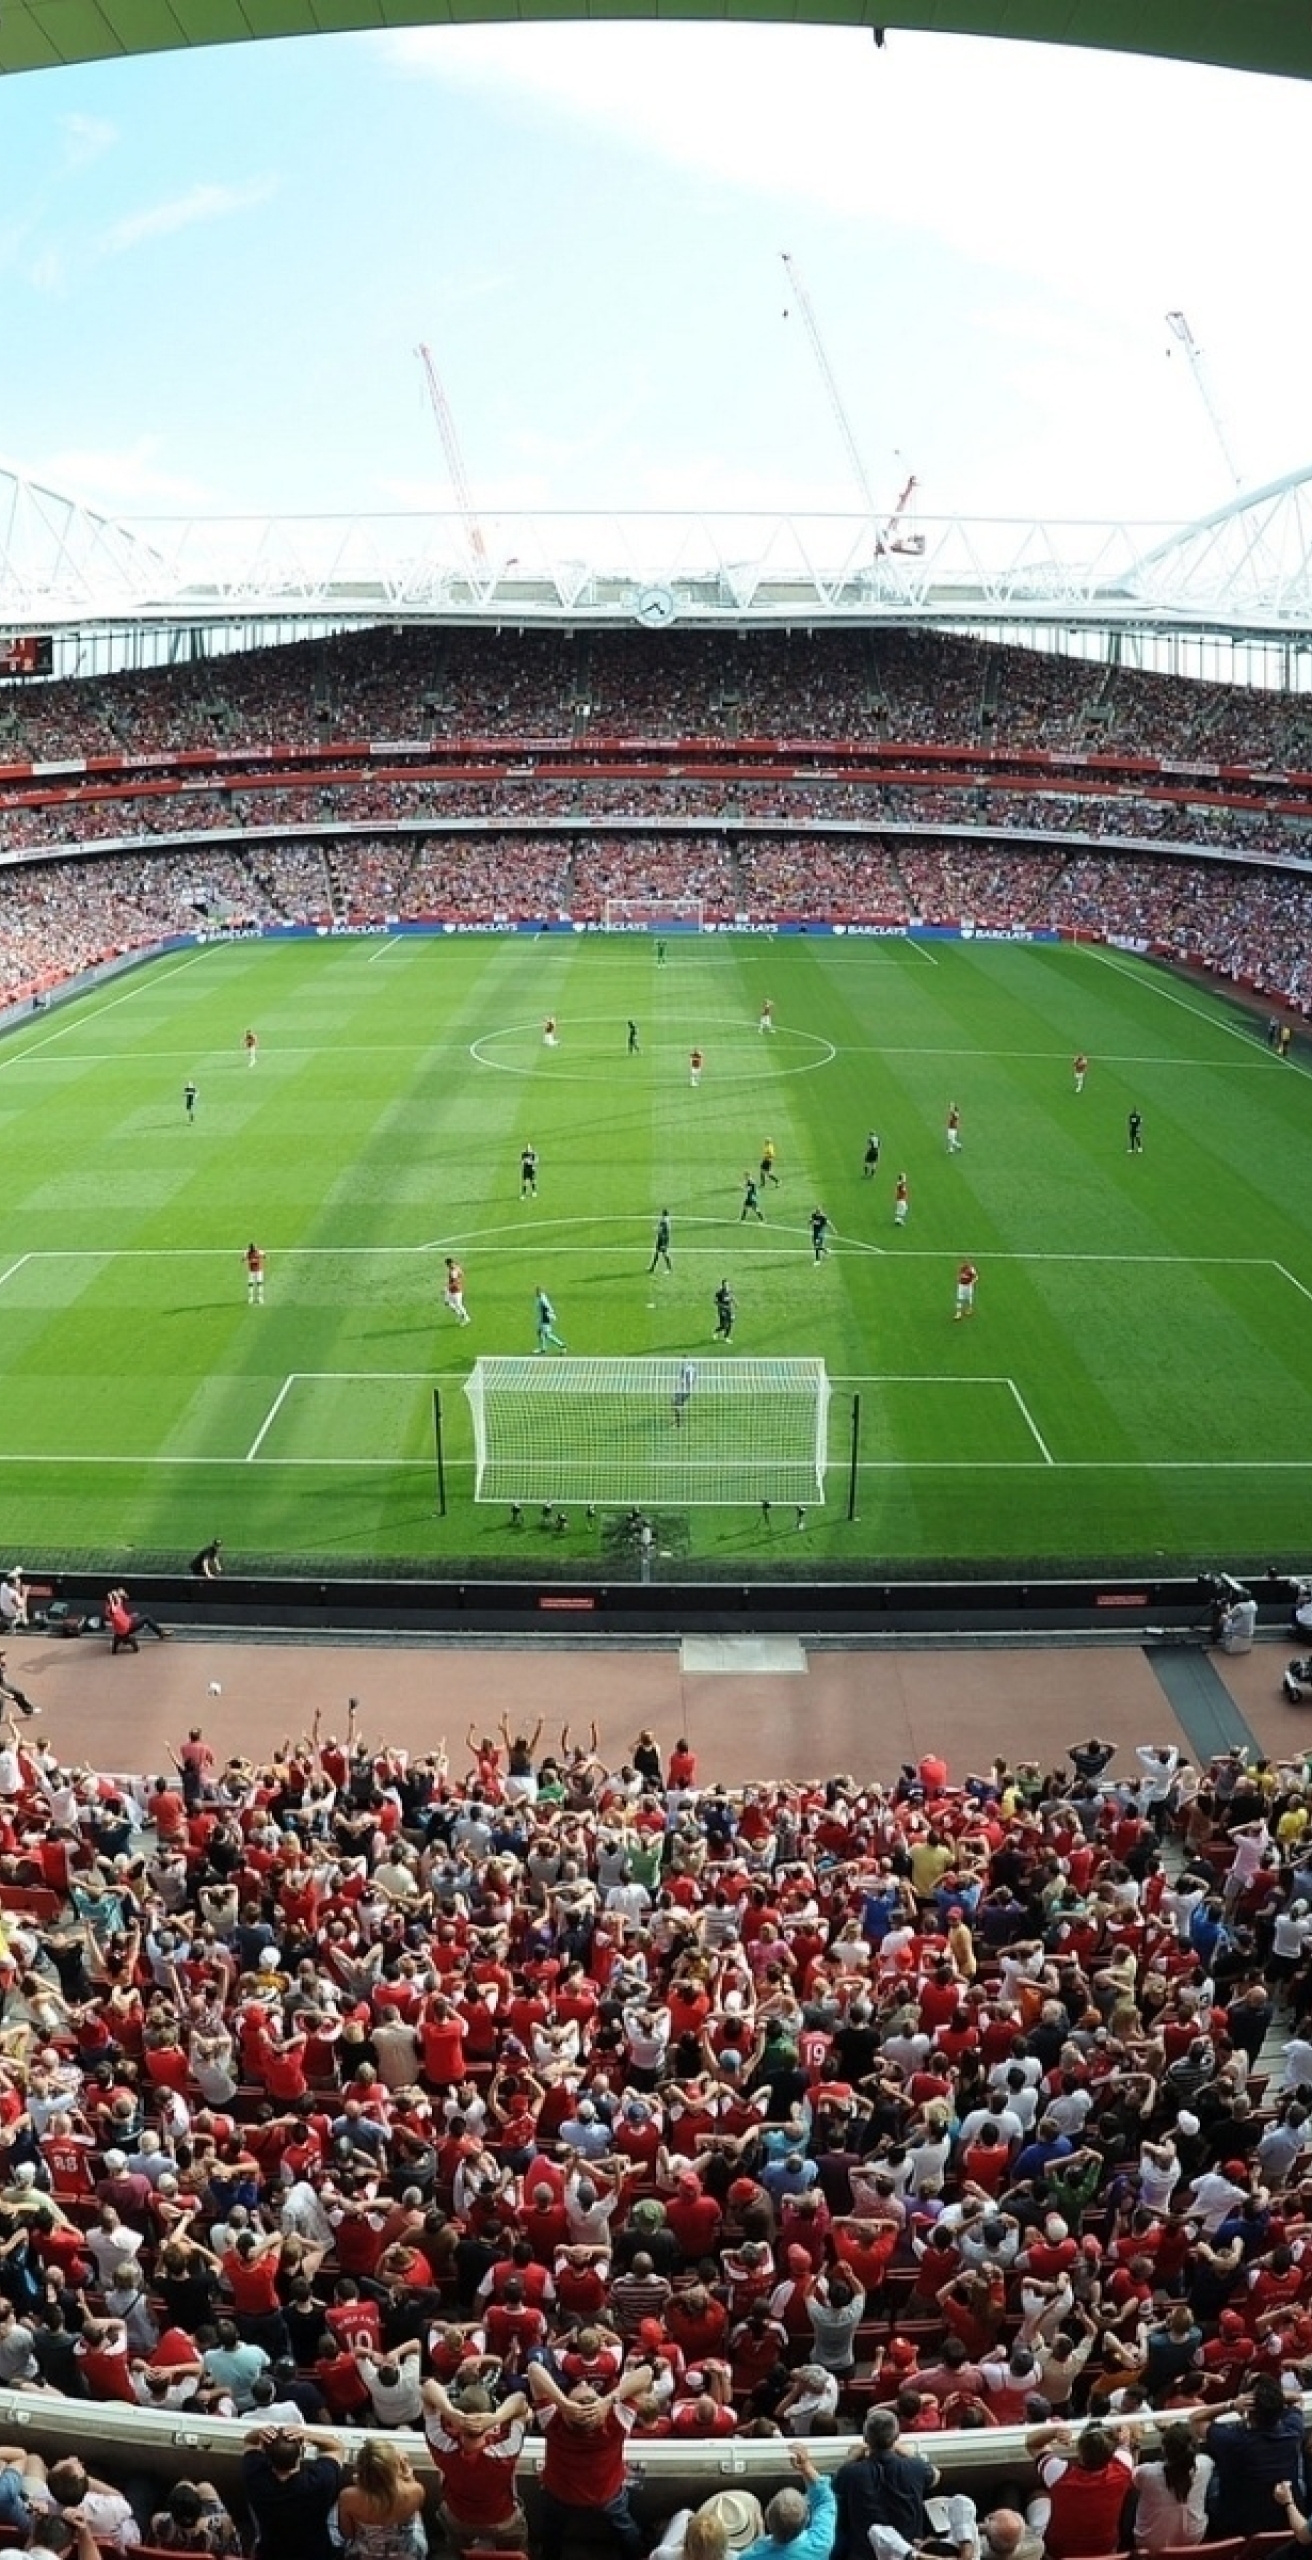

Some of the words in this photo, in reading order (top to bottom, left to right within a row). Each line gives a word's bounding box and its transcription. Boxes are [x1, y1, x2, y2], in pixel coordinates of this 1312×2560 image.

[332, 925, 389, 935] BARCLAYS
[458, 923, 518, 931] BARCLAYS
[719, 923, 778, 932] BARCLAYS
[848, 926, 907, 935] BARCLAYS
[975, 930, 1033, 940] BARCLAYS
[806, 2043, 826, 2066] 19
[346, 2329, 373, 2351] 10
